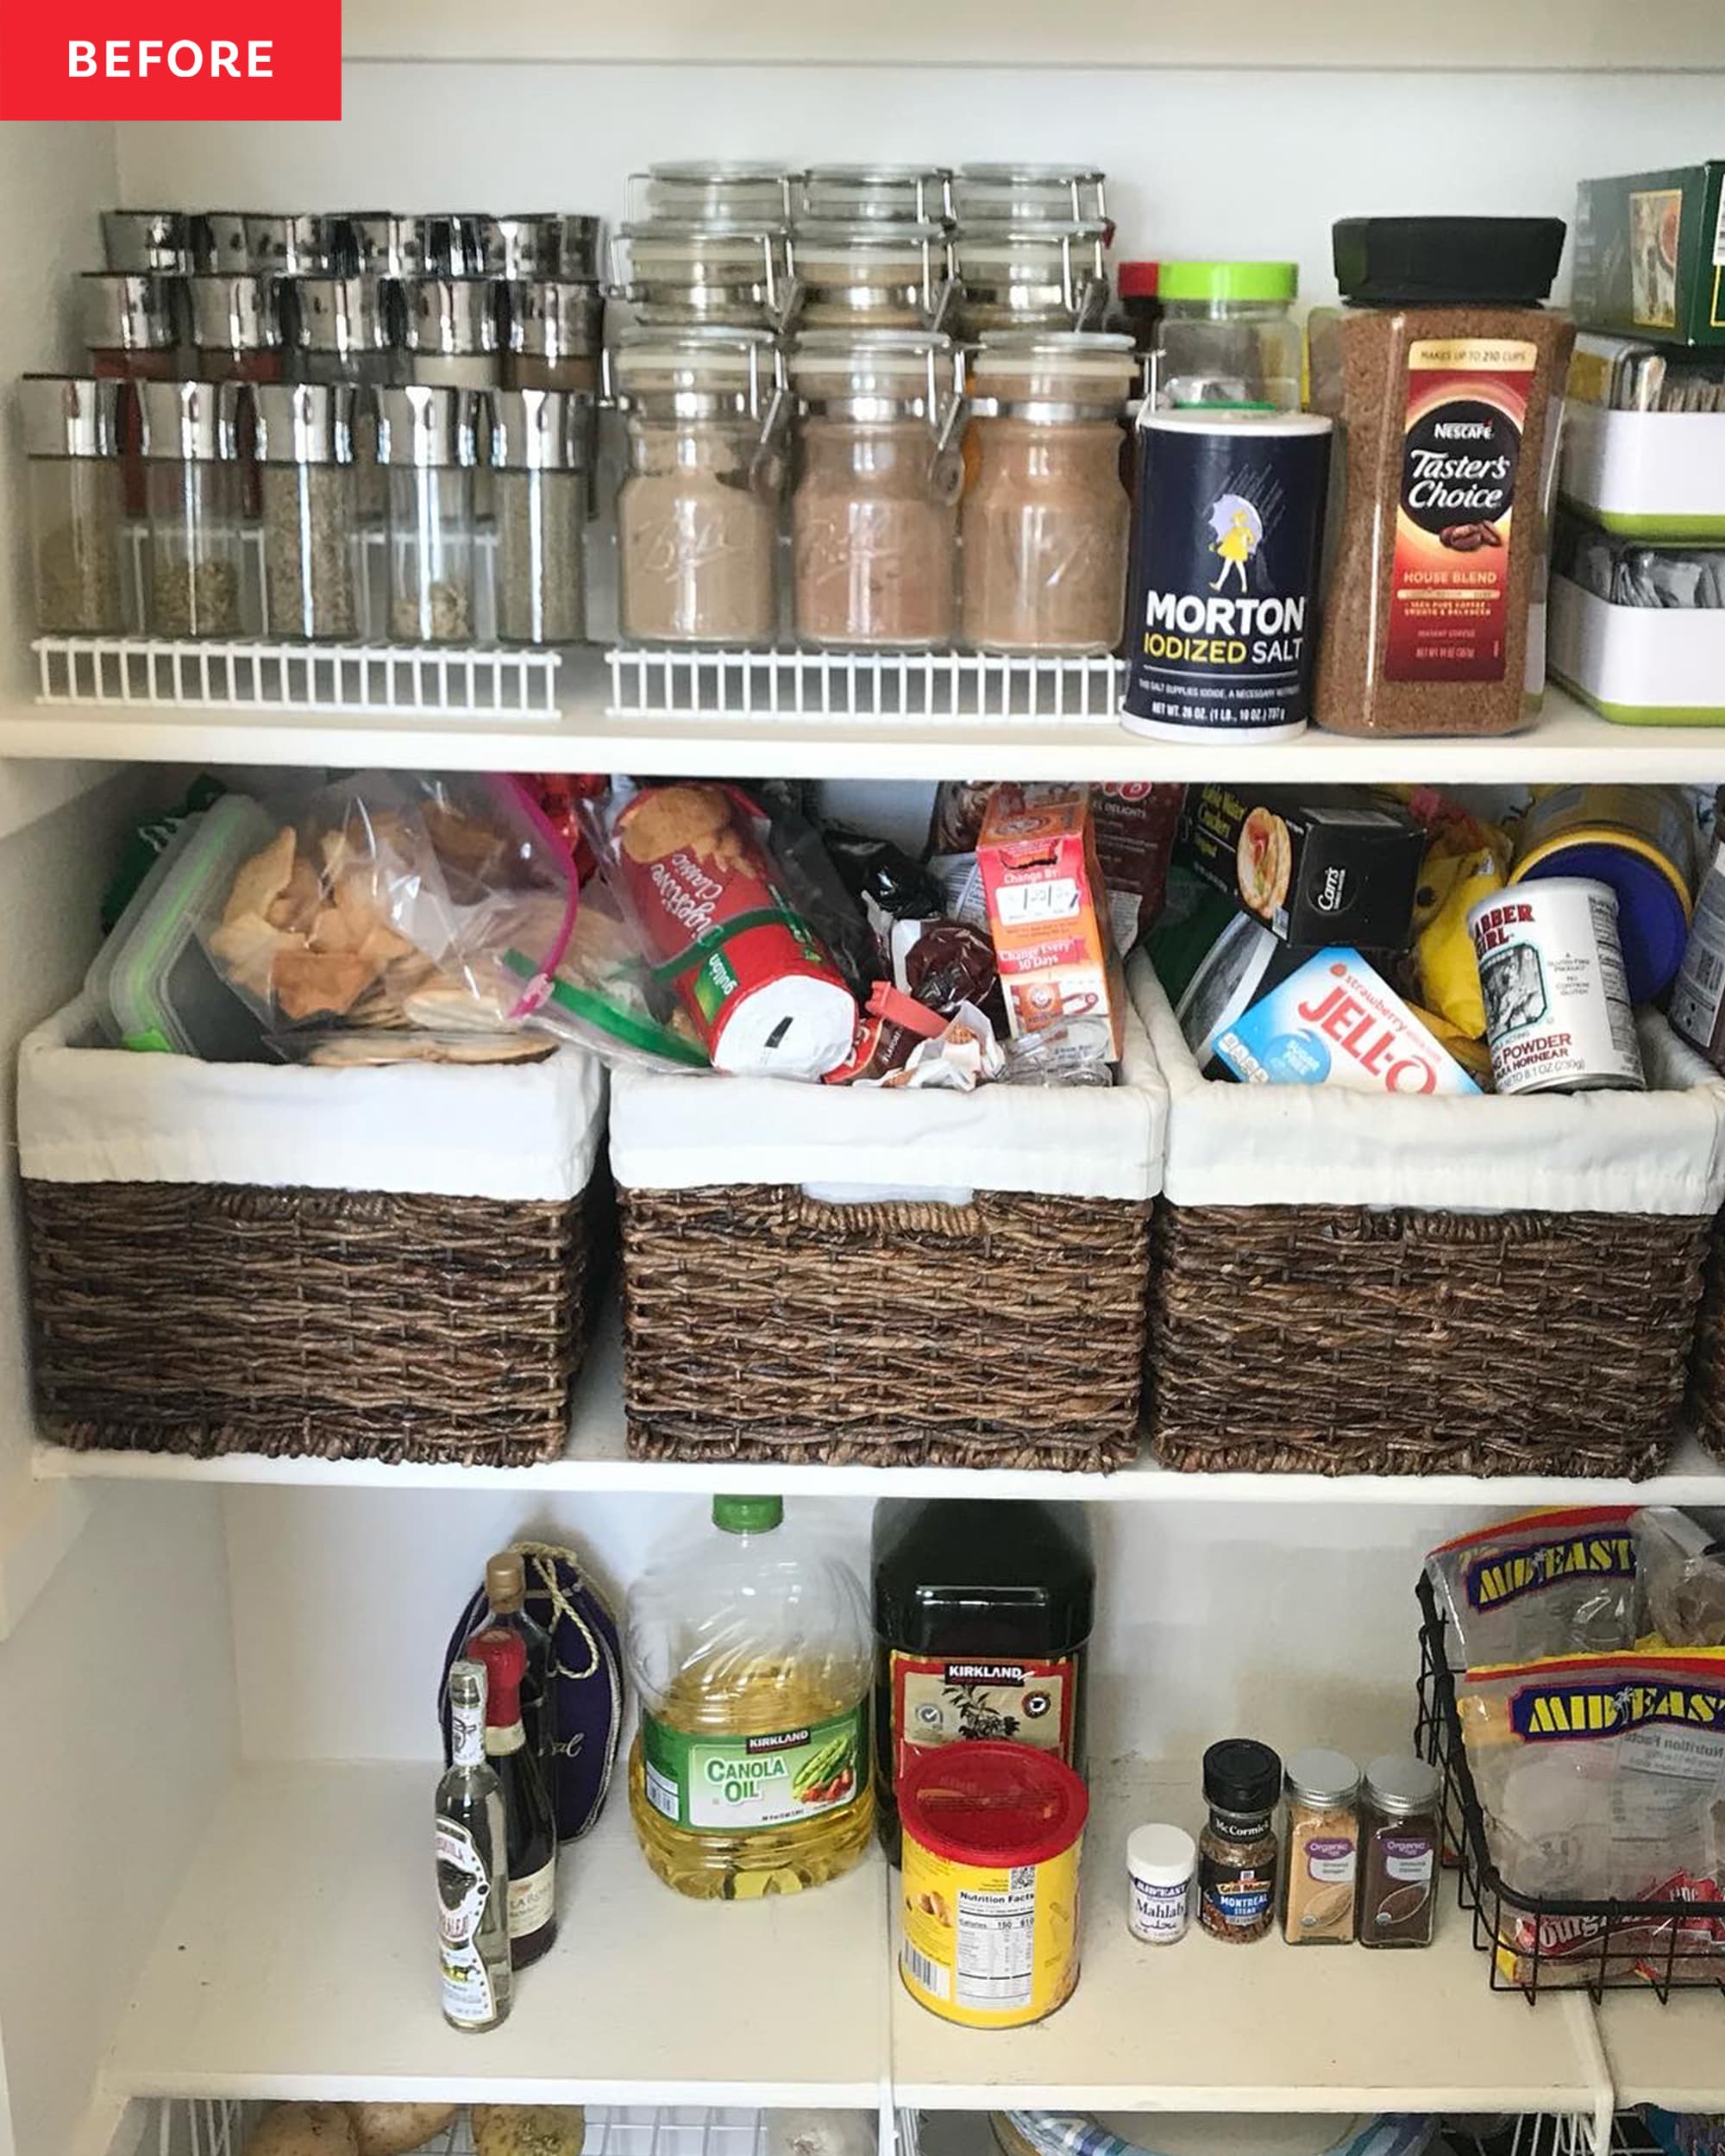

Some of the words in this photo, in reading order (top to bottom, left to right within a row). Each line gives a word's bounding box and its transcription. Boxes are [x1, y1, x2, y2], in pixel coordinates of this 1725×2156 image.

[1410, 449, 1510, 479] Taster's
[1408, 479, 1503, 509] Choice
[1404, 571, 1449, 584] HOUSE
[1452, 571, 1497, 584] BLEND
[1146, 591, 1305, 636] MORTON
[1144, 632, 1247, 663] IODIZED
[1251, 638, 1303, 664] SALT
[672, 854, 723, 899] Classic
[1004, 871, 1042, 884] Change
[650, 863, 723, 947] Digestive
[999, 947, 1039, 962] Change
[1019, 958, 1032, 970] 30
[1034, 954, 1059, 968] Days
[1346, 975, 1408, 1032] strawberry
[1298, 986, 1437, 1095] JELL-O
[1502, 1032, 1572, 1064] POWDER
[1513, 1048, 1569, 1070] HORNEAR
[1479, 1557, 1534, 1604] MID
[1544, 1538, 1636, 1579] EAST
[949, 1665, 1023, 1679] KIRKLAND
[1528, 1694, 1619, 1733] MID
[1630, 1687, 1725, 1723] EAS
[749, 1730, 809, 1749] KIRKLAND
[1309, 1842, 1348, 1853] Organic
[1387, 1841, 1426, 1852] Organic
[960, 1891, 1005, 1904] Nutrition
[1008, 1891, 1034, 1903] Facts
[1137, 1898, 1184, 1918] Mahlab
[1220, 1894, 1268, 1908] MONTREAL
